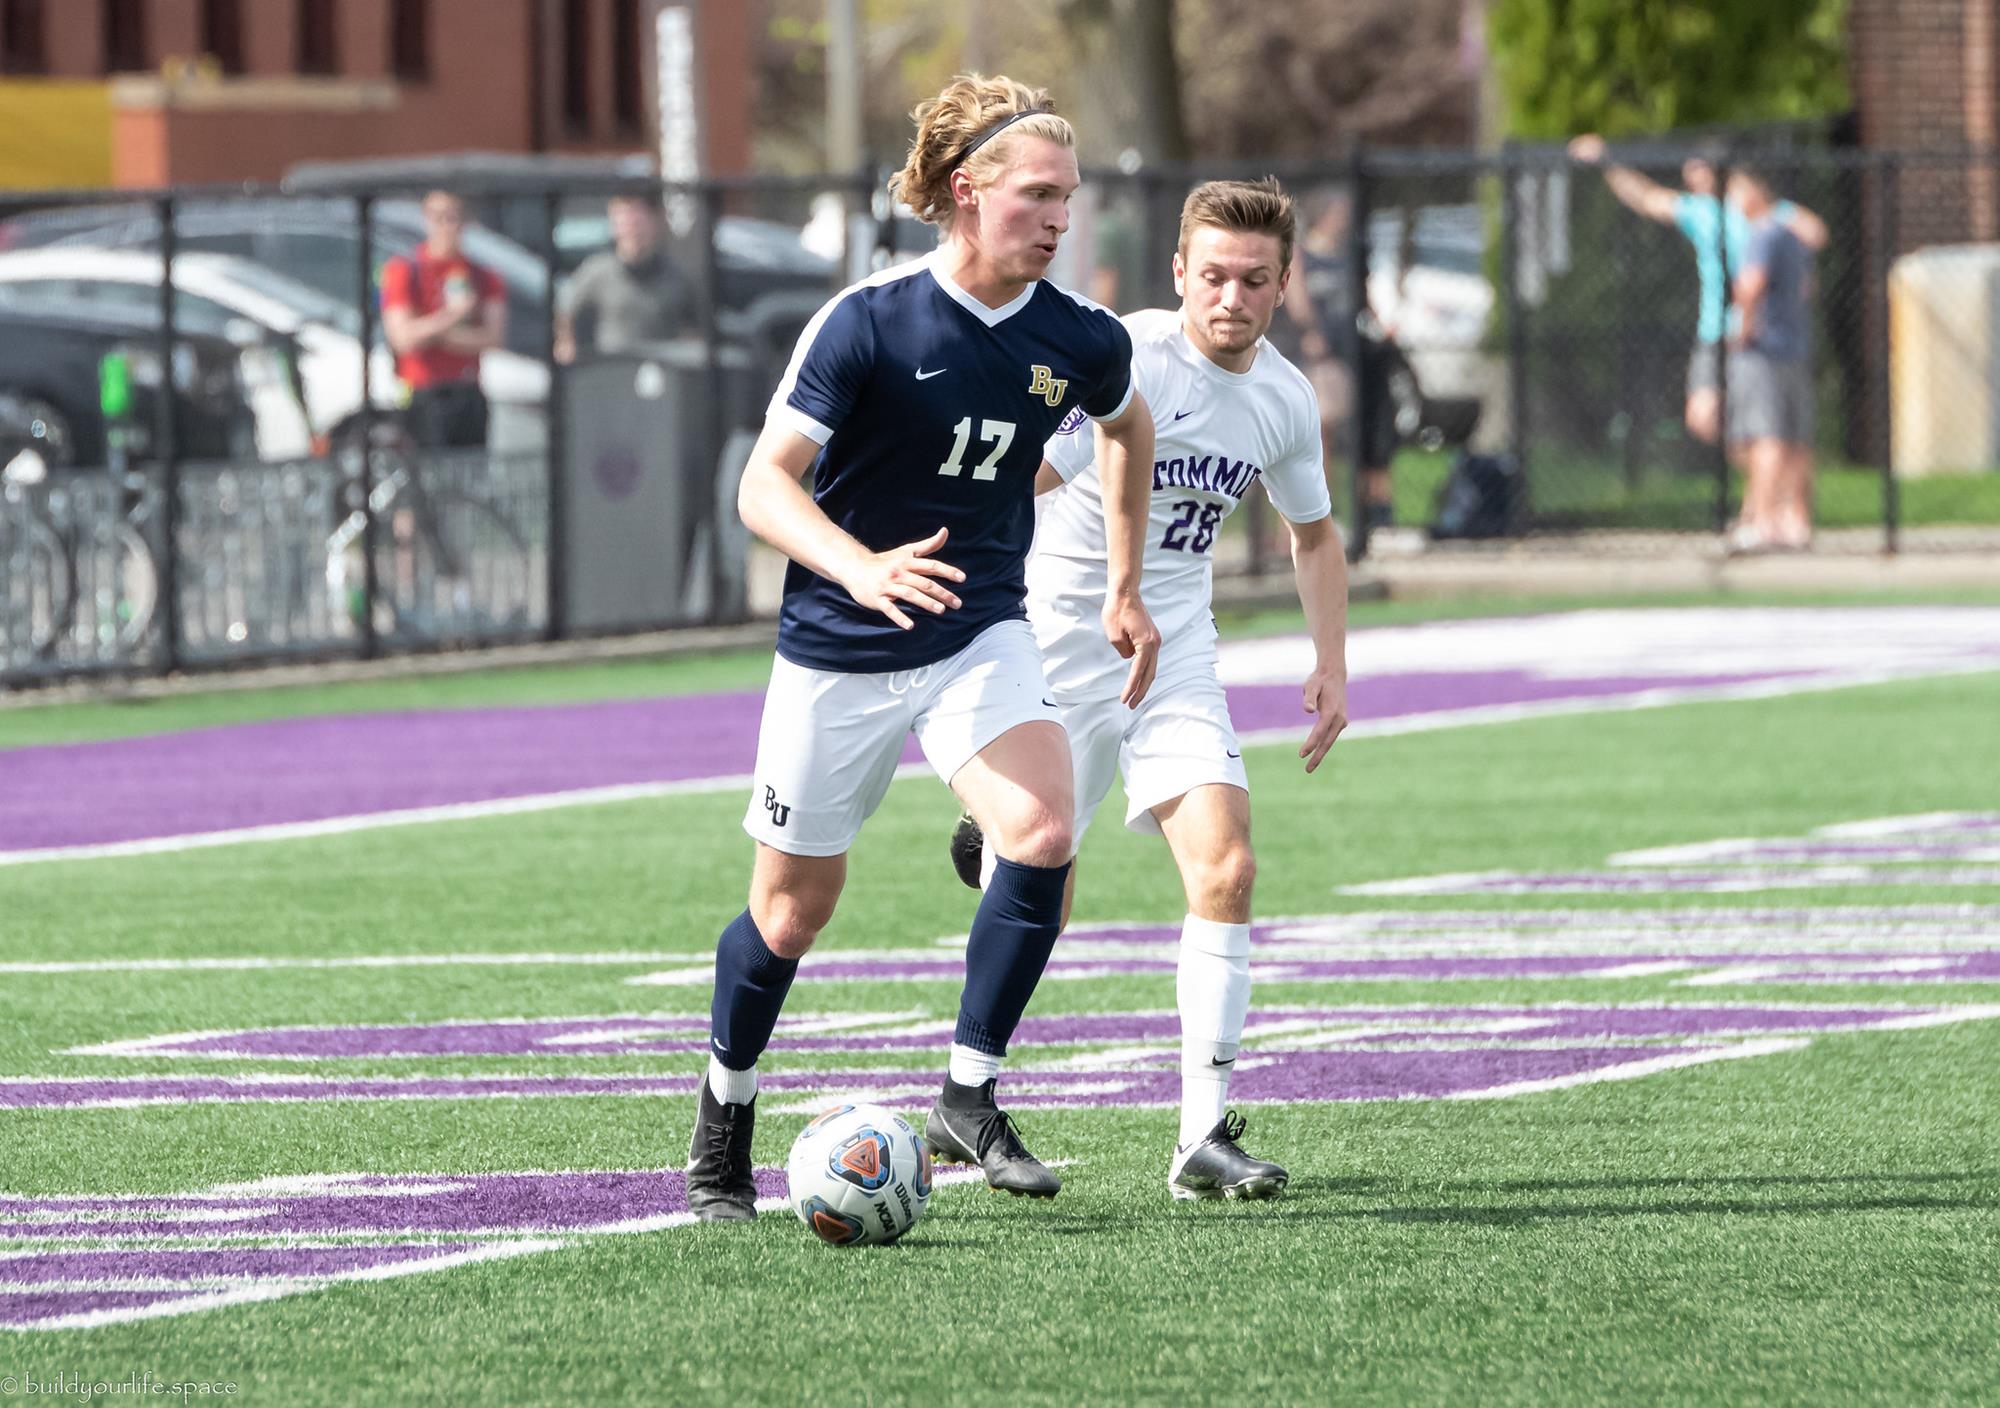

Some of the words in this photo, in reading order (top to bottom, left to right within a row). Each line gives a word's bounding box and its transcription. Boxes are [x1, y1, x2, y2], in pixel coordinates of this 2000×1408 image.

[1028, 364, 1068, 407] BU
[938, 416, 1016, 481] 17
[1159, 500, 1223, 553] 28
[765, 784, 791, 827] BU
